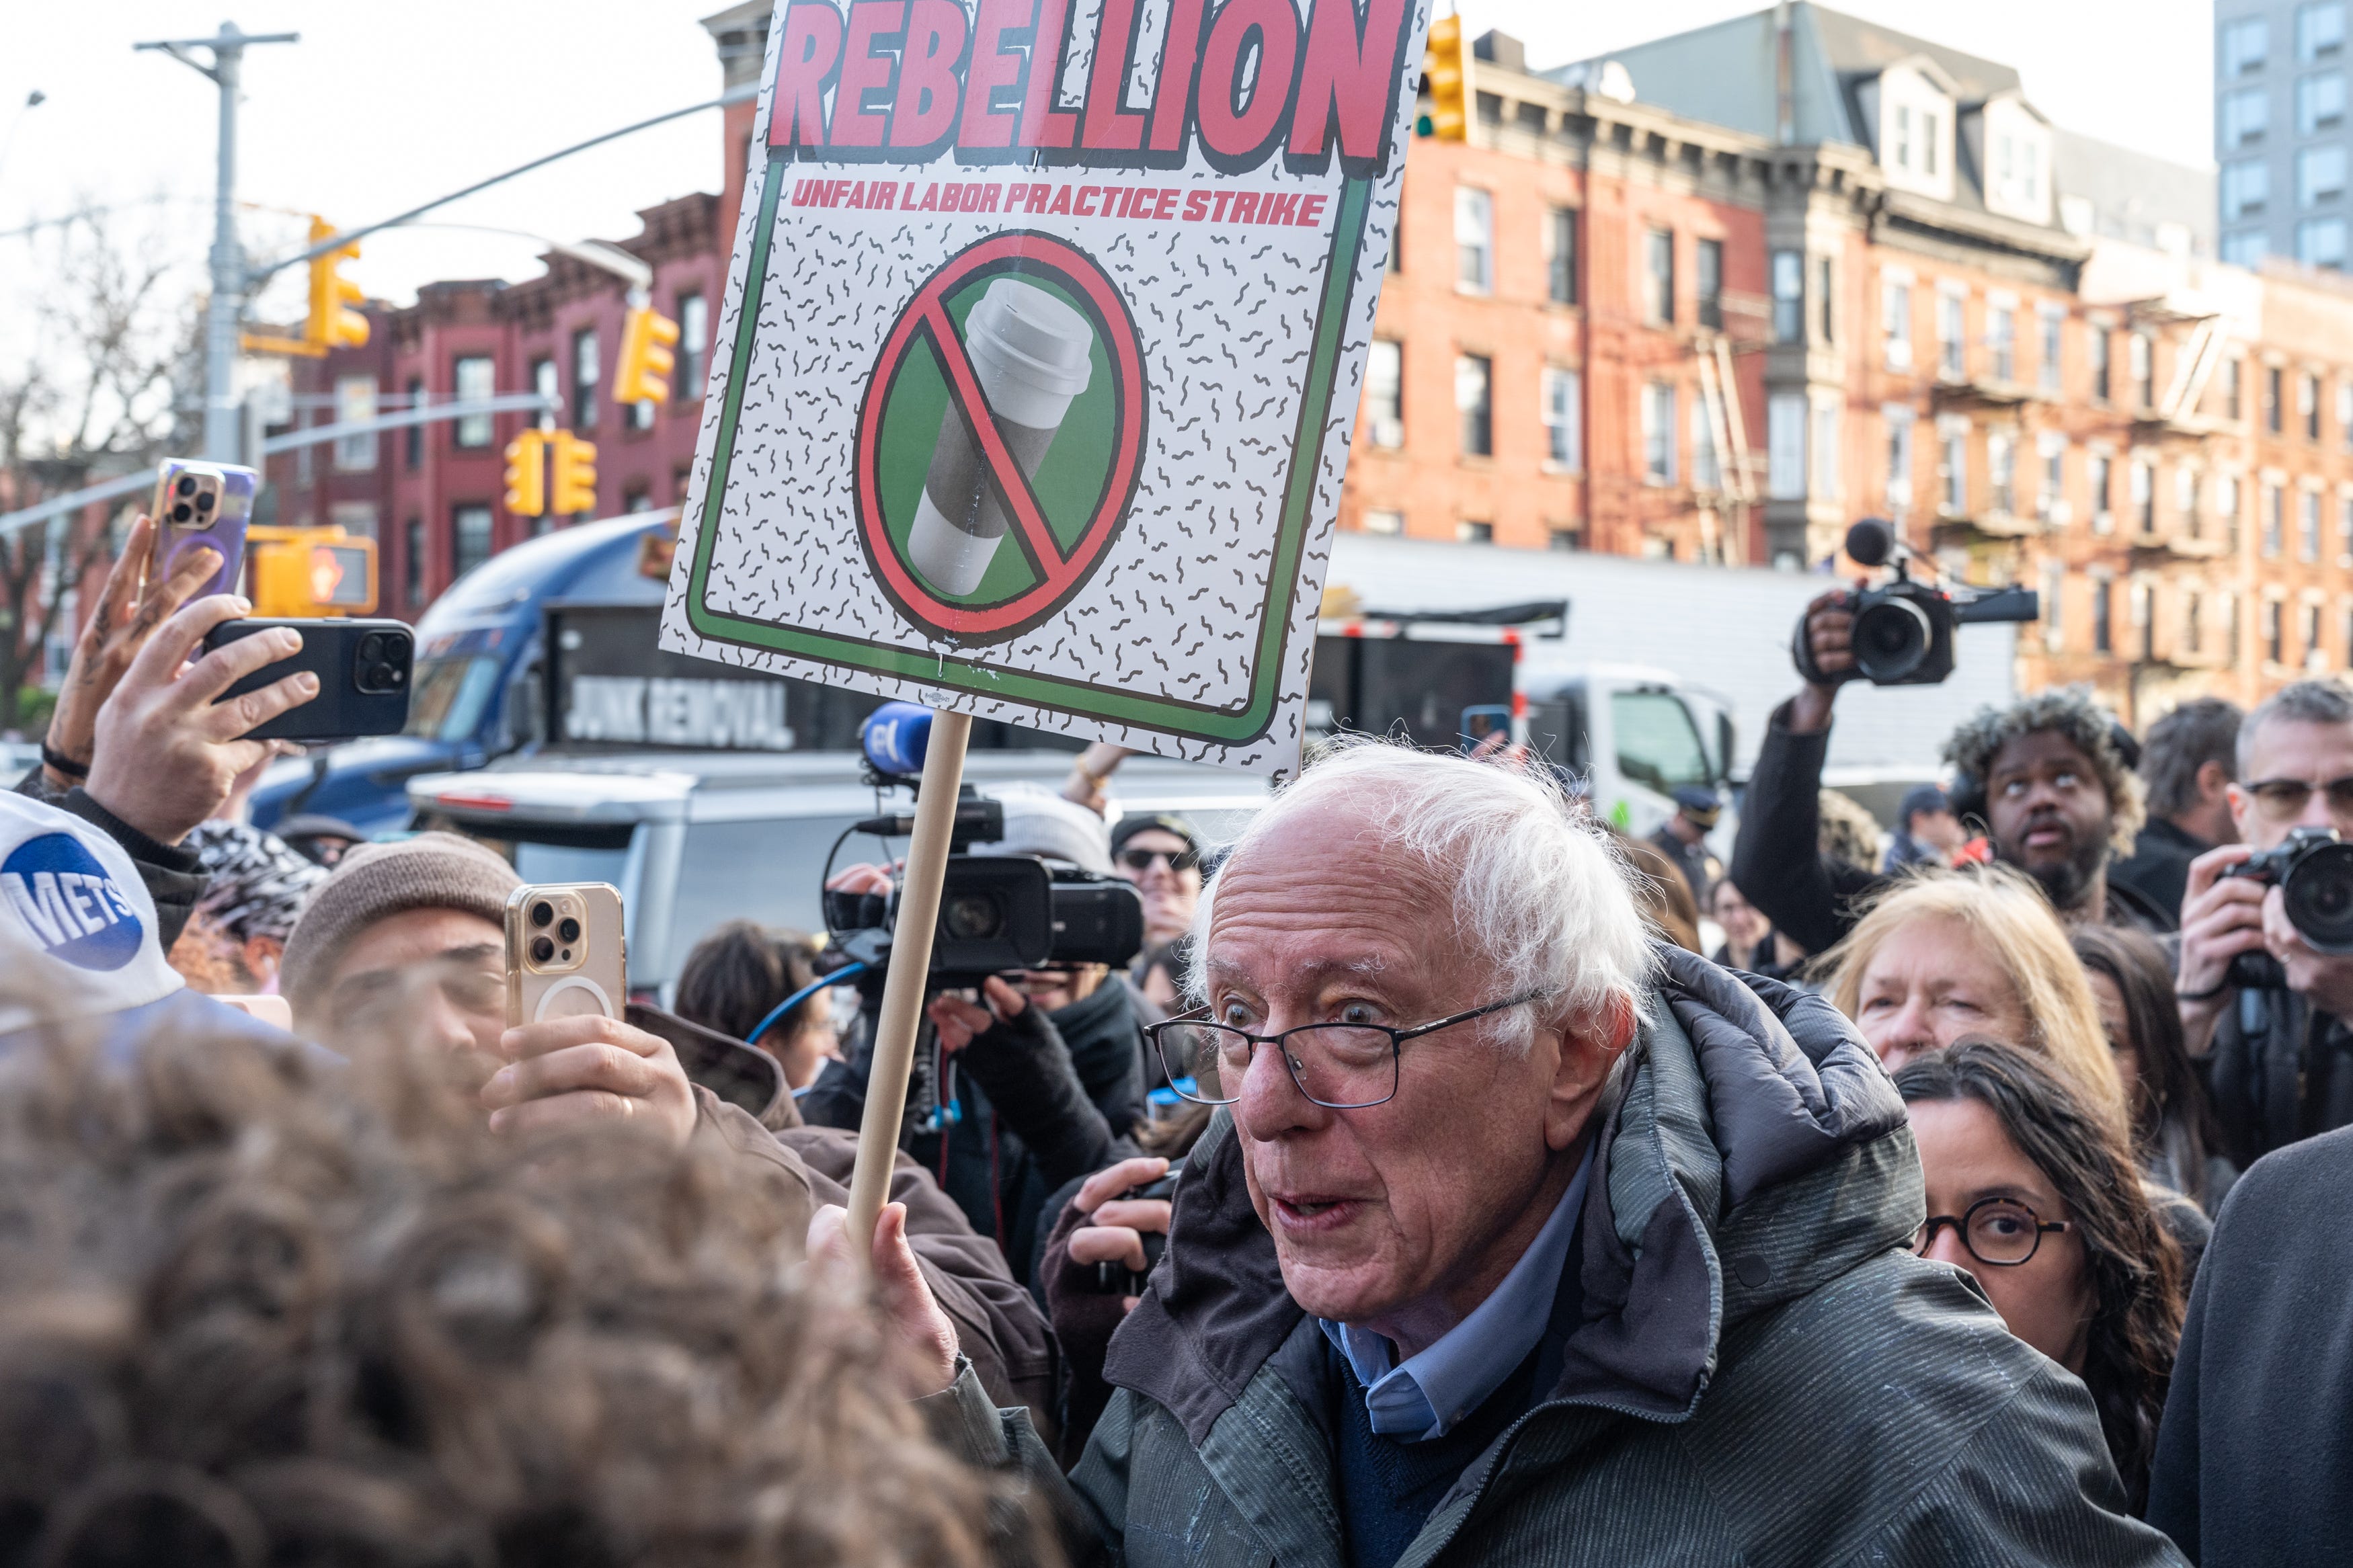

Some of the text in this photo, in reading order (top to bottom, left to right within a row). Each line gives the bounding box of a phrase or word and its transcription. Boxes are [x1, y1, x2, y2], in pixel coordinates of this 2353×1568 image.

[766, 0, 1410, 176] REBELLION
[791, 179, 1328, 227] UNFAIR LABOR PRACTICE STRIKE
[2, 872, 134, 950] METS
